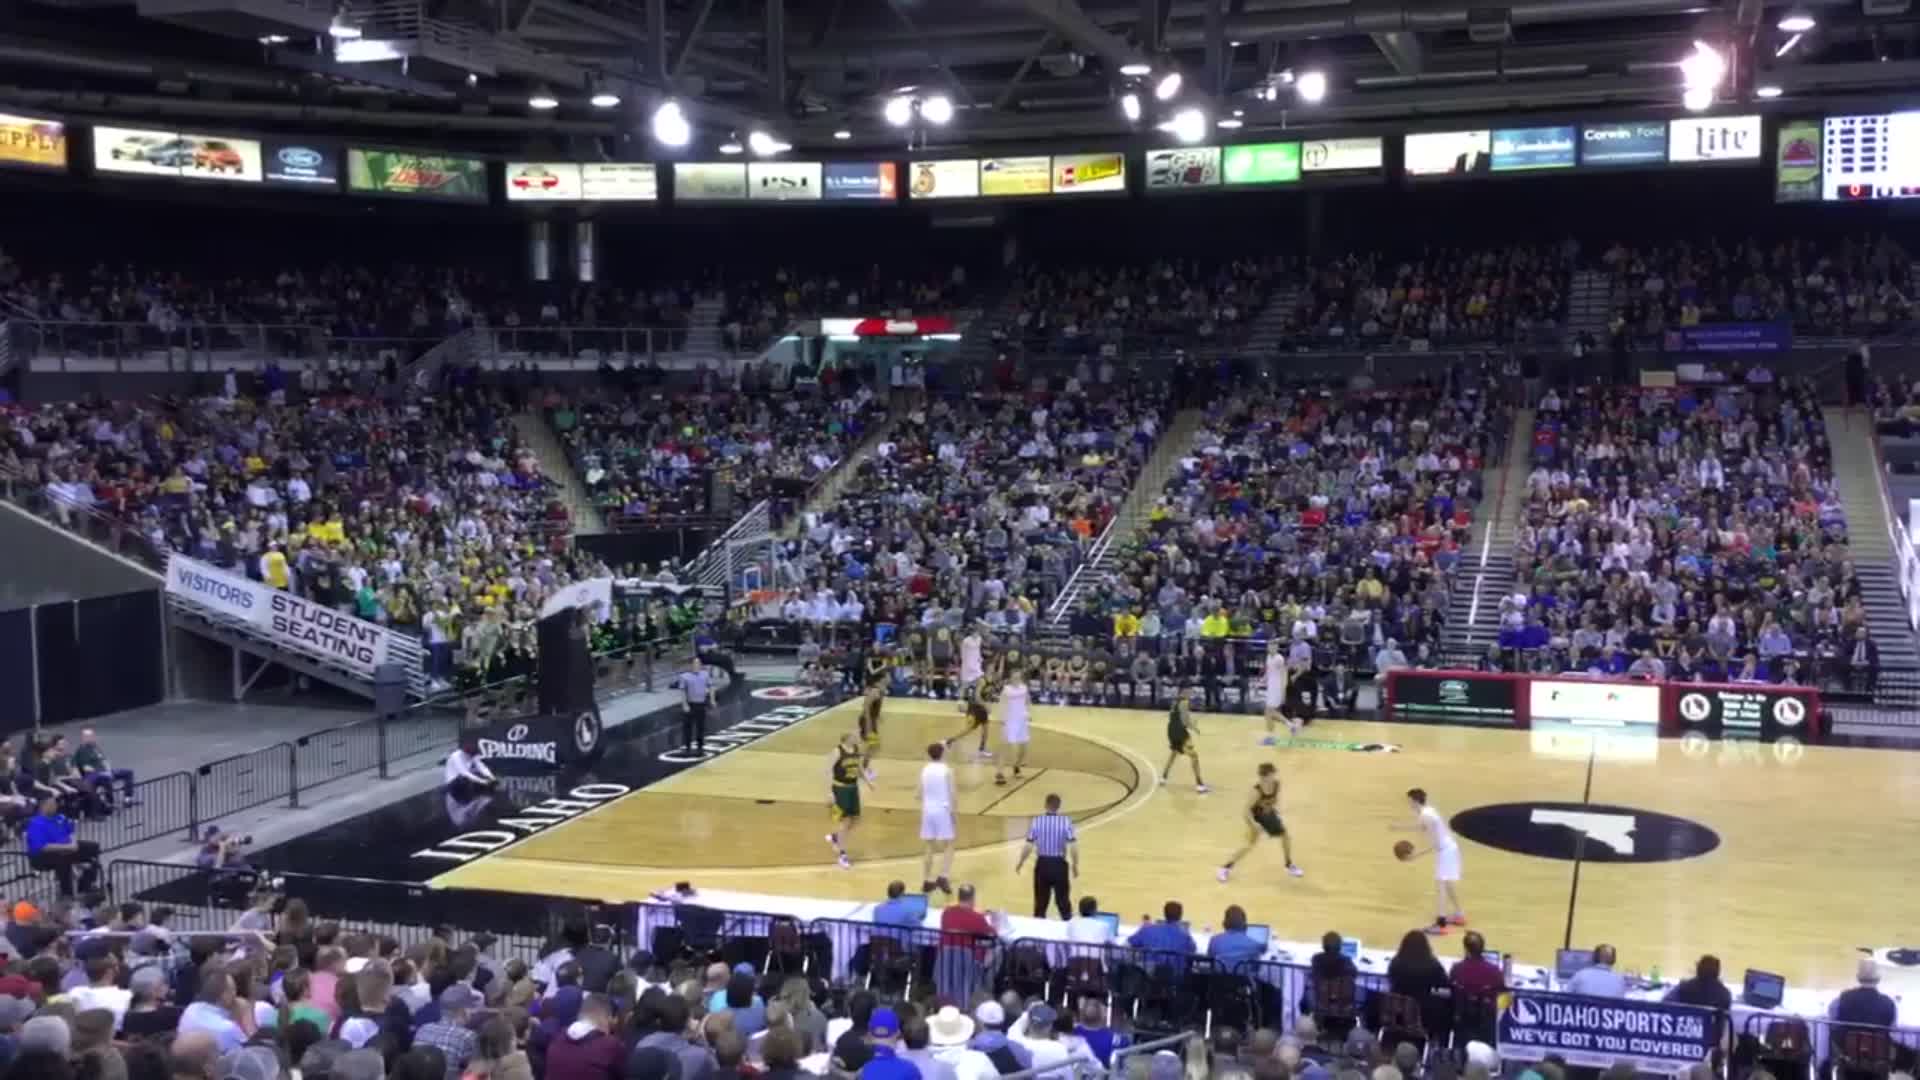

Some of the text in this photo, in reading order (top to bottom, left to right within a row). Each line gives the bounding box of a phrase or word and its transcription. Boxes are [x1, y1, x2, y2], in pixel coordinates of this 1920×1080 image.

[1583, 126, 1665, 141] Corwin Ford
[1695, 126, 1748, 158] Lite
[177, 567, 255, 609] VISITORS
[272, 593, 381, 646] STUDENT
[272, 615, 374, 664] SEATING
[478, 738, 556, 764] SPALDING
[657, 705, 830, 763] CENTER
[410, 783, 630, 862] IDAHO
[1509, 1027, 1704, 1058] WE'VE GOT YOU COVERED
